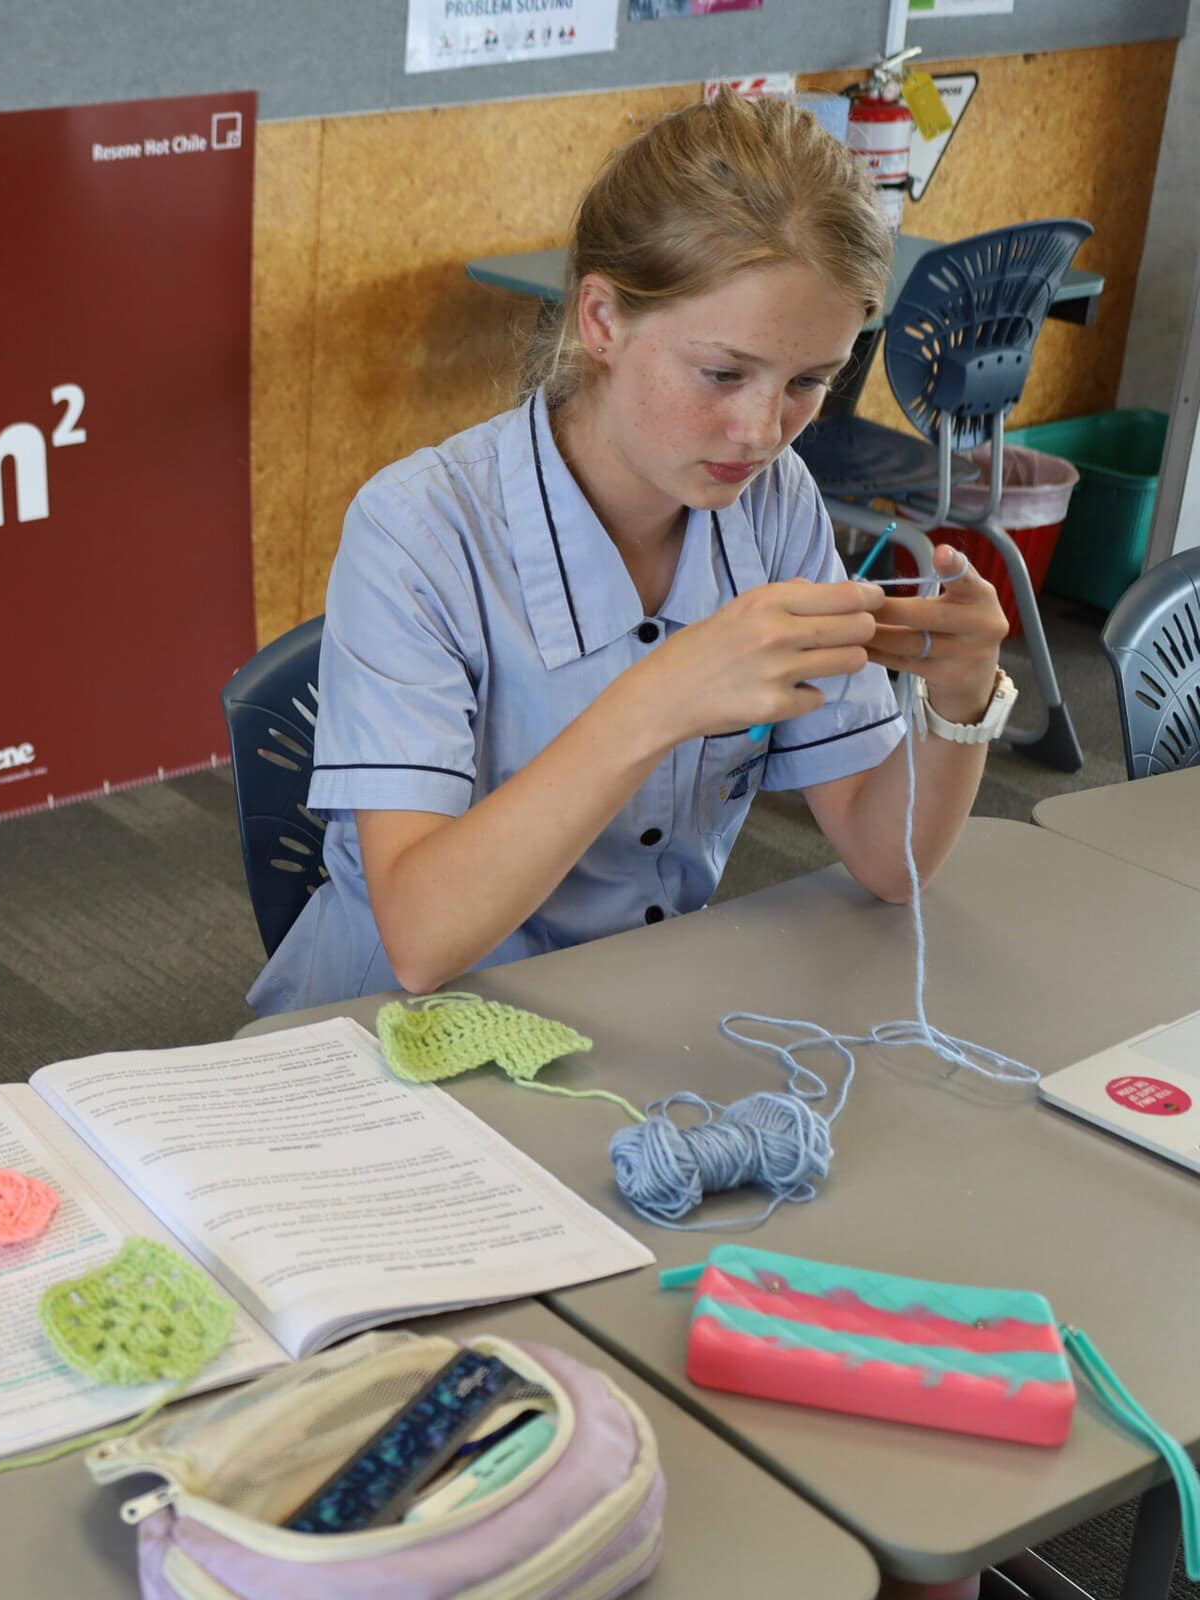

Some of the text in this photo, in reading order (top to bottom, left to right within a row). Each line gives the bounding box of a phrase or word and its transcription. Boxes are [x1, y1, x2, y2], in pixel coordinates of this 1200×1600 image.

[444, 0, 513, 18] PROBLEM
[91, 132, 208, 162] Resene Hot Chile
